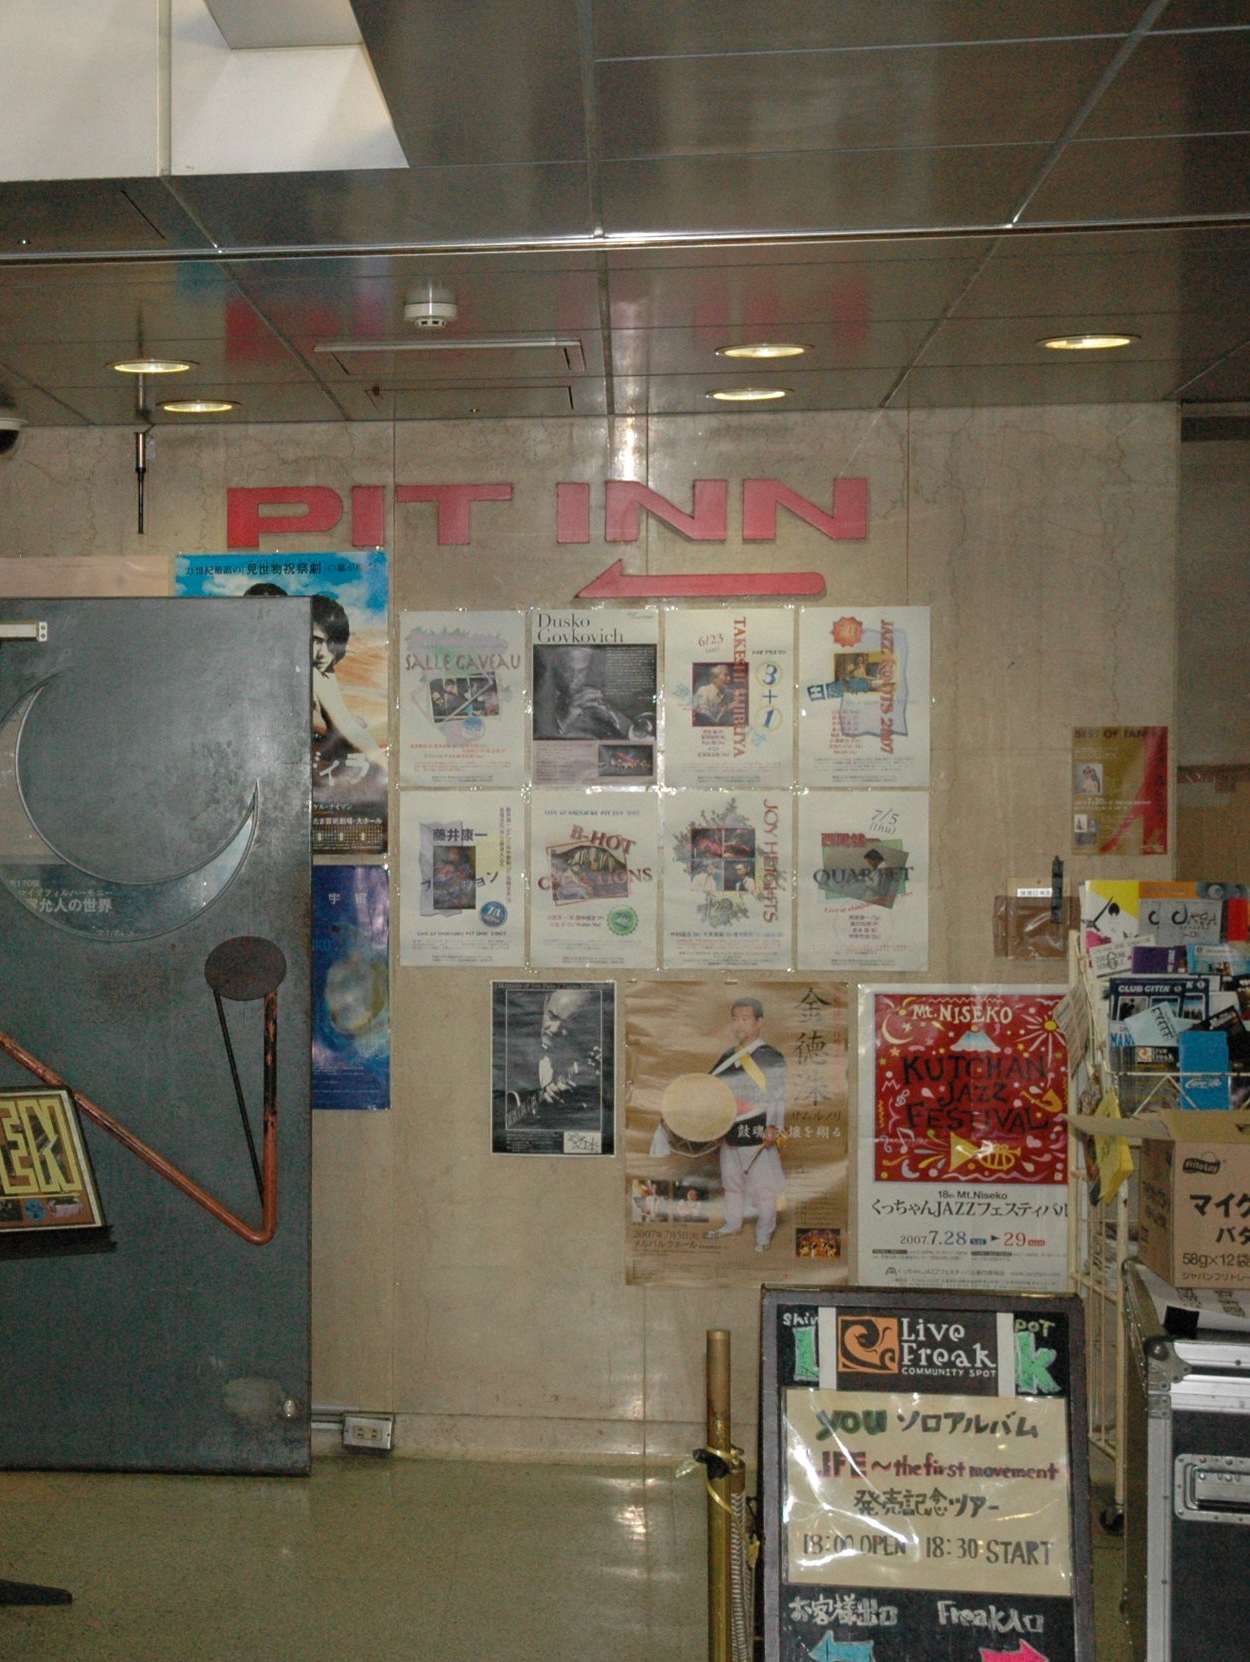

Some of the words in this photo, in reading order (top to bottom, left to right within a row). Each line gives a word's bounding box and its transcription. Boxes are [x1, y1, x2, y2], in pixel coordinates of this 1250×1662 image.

[226, 484, 512, 548] PIT
[556, 478, 868, 544] INN
[538, 613, 590, 628] Dusko
[697, 633, 724, 647] 6/23
[406, 653, 451, 671] SALLE
[455, 653, 521, 670] GAVEAU
[763, 799, 779, 838] JOY
[871, 807, 899, 825] 7/5
[432, 828, 488, 842] 藤井康一
[570, 824, 636, 855] B-HOT
[813, 866, 914, 886] QUARTET
[1118, 985, 1143, 993] CLUB
[912, 1005, 937, 1020] Mt.
[939, 1005, 1013, 1025] NISEKO
[903, 1055, 1047, 1084] KUTCHAN
[938, 1081, 1008, 1109] JAZZ
[905, 1101, 1049, 1133] FESTIVAL
[1004, 1231, 1027, 1247] 29
[901, 1318, 965, 1342] Live
[901, 1342, 997, 1367] Freak
[902, 1367, 965, 1377] COMMUNITY
[969, 1369, 997, 1378] SPOT
[897, 1411, 1039, 1438] ソロアルバム
[969, 1459, 1060, 1481] movement
[854, 1487, 999, 1517] 発売記念ツアー
[803, 1534, 854, 1555] 18:00
[859, 1535, 906, 1556] OPEN
[926, 1536, 979, 1559] 18:30
[986, 1539, 1054, 1565] START
